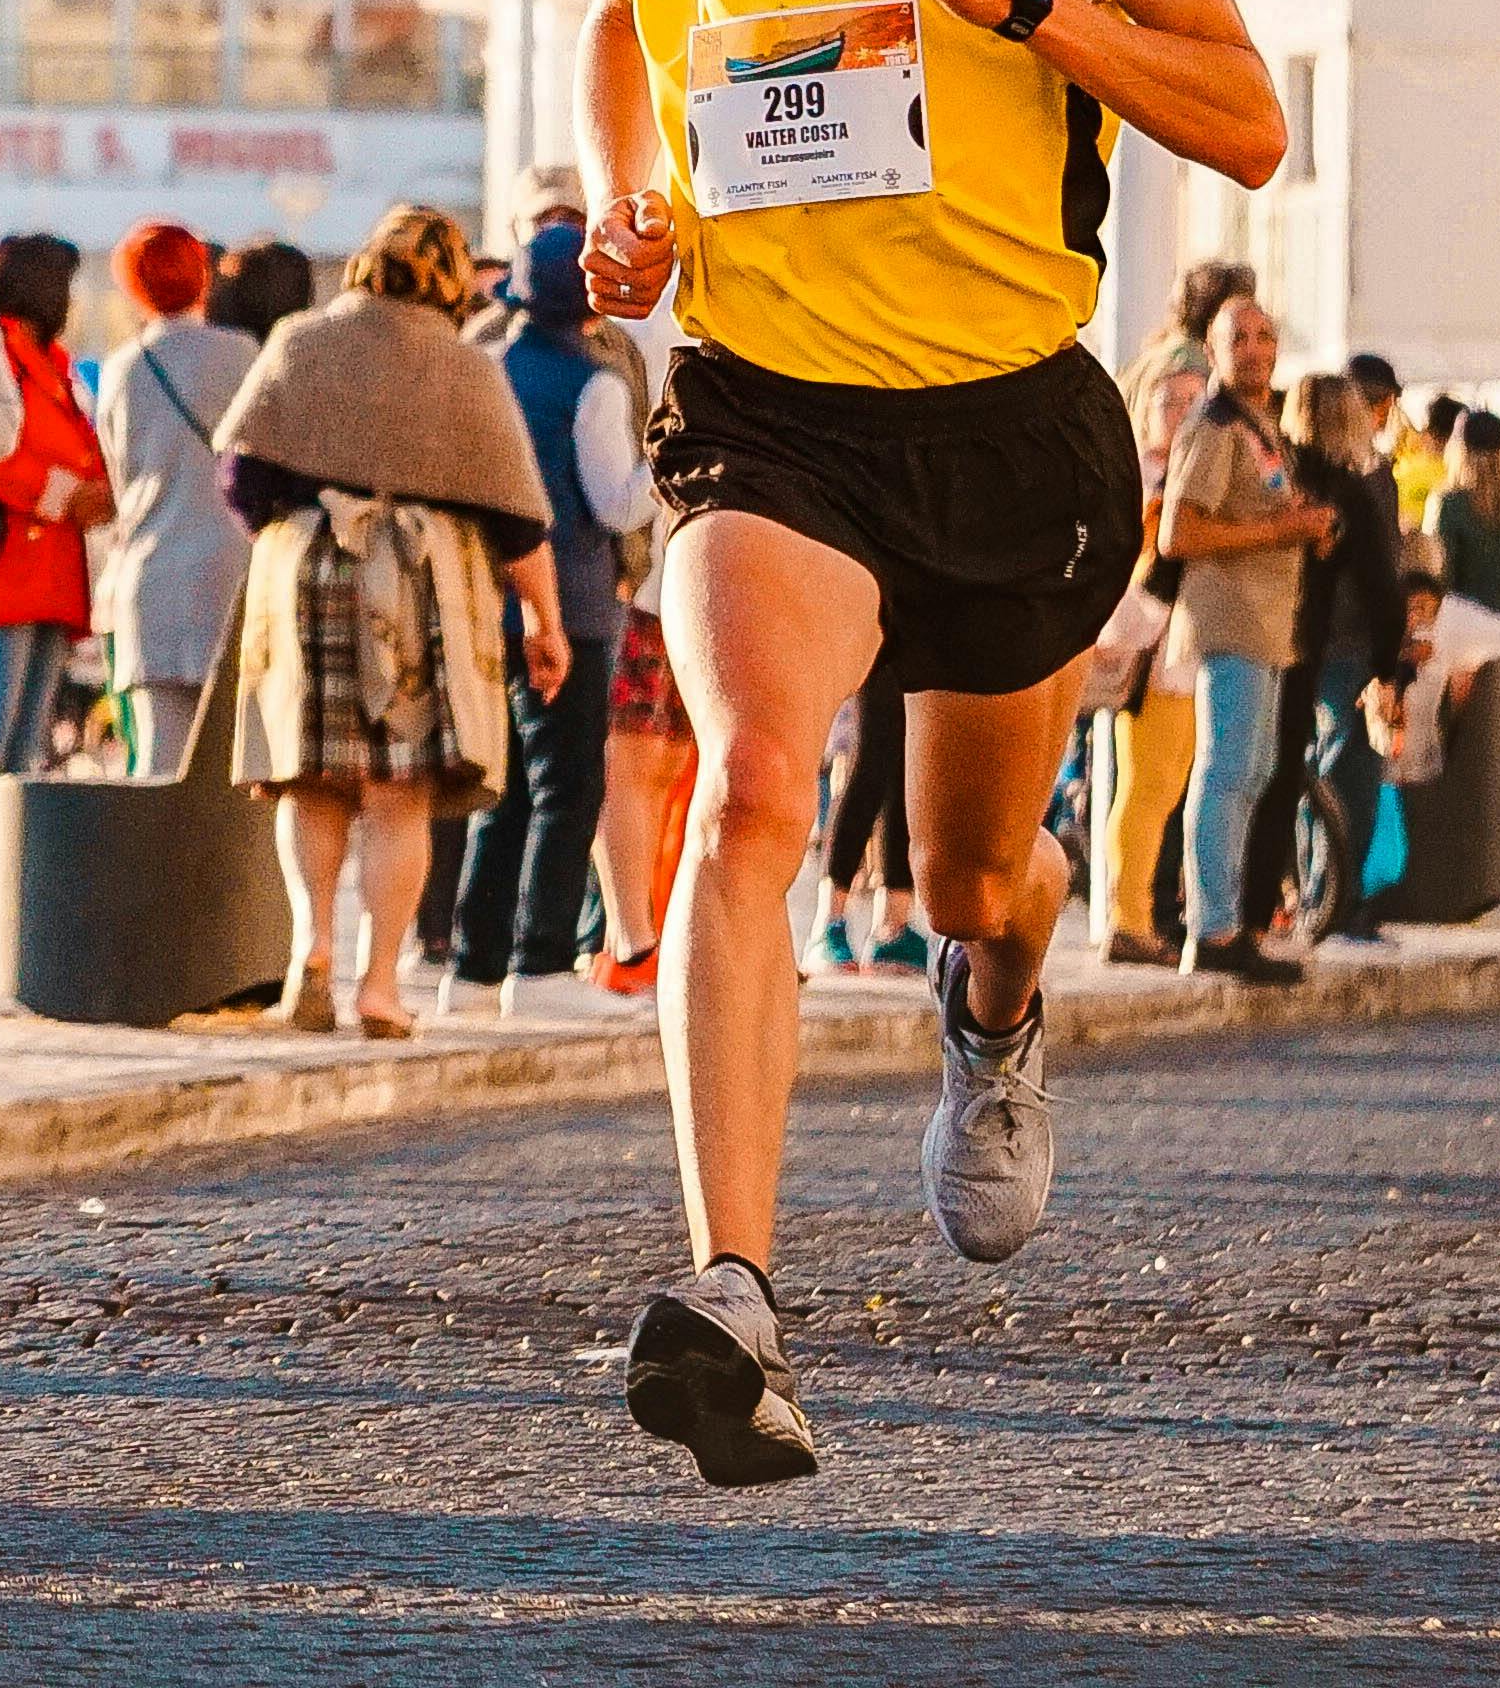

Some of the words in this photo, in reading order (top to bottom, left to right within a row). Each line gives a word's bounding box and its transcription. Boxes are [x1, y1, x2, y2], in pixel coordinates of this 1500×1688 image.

[763, 81, 825, 123] 299
[745, 126, 797, 149] VALTER
[800, 121, 850, 144] COSTA
[726, 181, 766, 194] ATLANTIK
[767, 179, 788, 190] FISH
[811, 172, 854, 184] ATLANTIK
[855, 170, 877, 180] FISH
